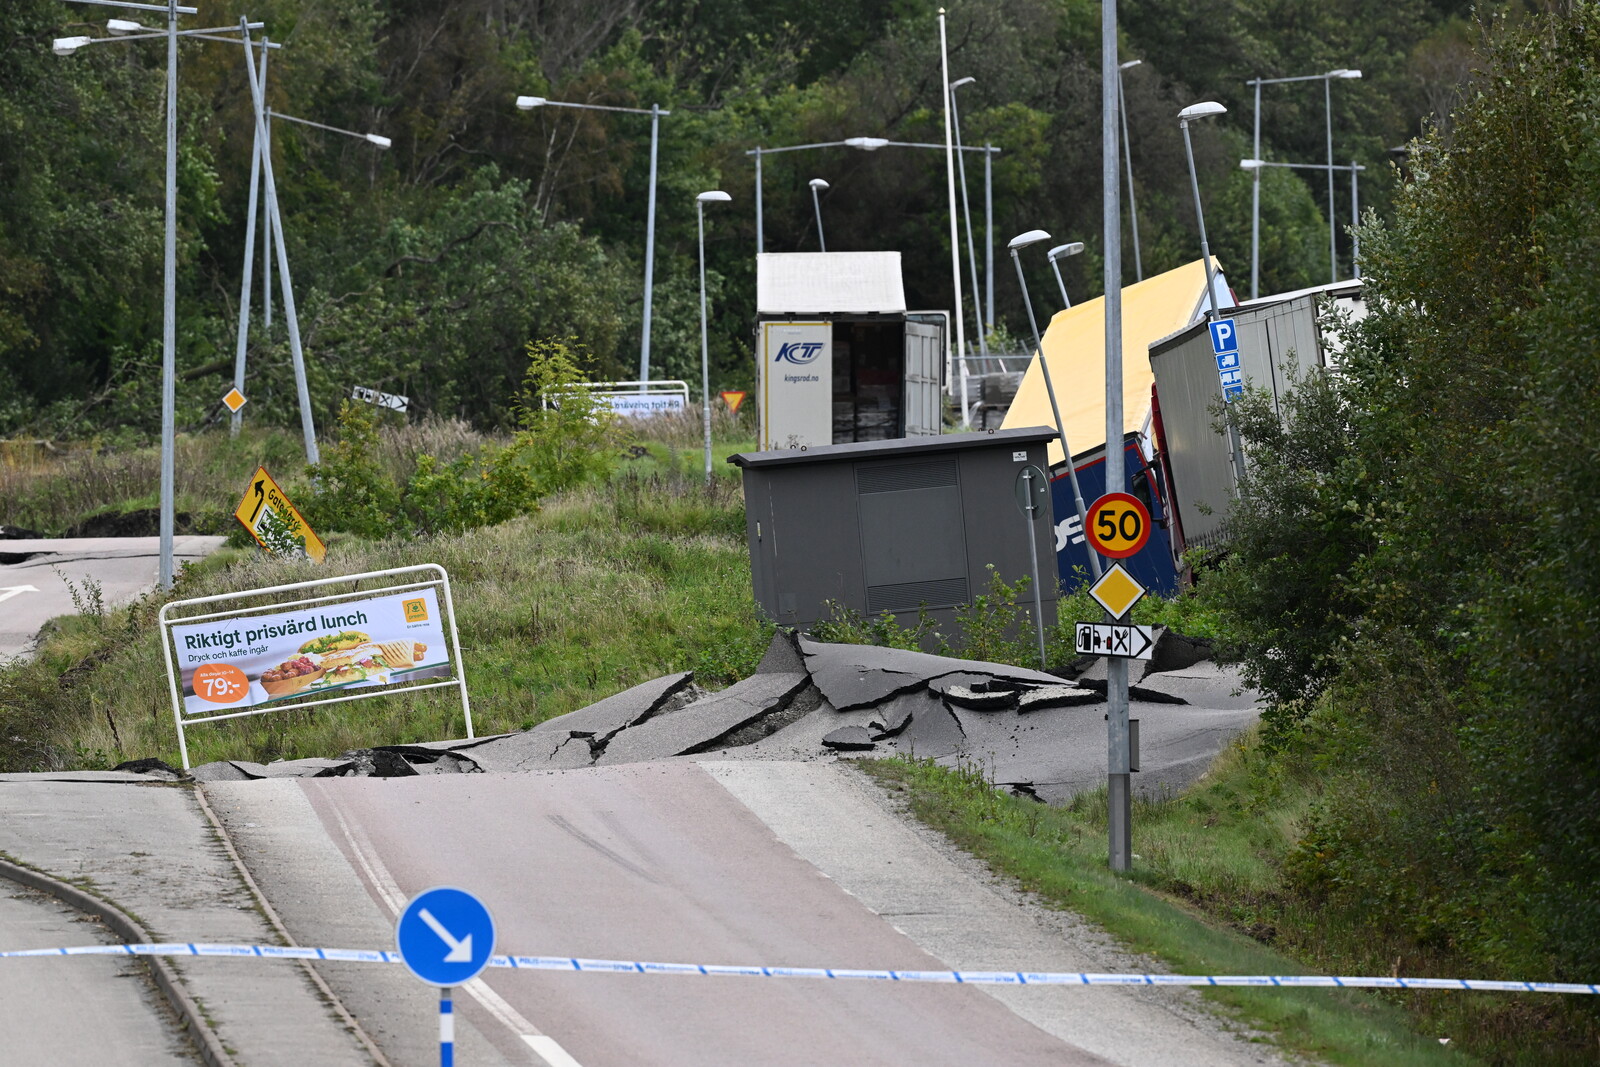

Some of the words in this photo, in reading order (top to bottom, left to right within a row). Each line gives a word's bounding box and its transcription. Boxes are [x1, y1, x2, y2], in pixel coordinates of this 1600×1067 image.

[1216, 323, 1232, 350] P
[1098, 510, 1141, 542] 50
[185, 630, 241, 650] Riktigt
[245, 616, 317, 645] prisvärd
[320, 610, 368, 630] lunch
[188, 651, 210, 663] Dryck
[212, 650, 227, 660] och
[228, 647, 248, 658] kaffe
[249, 644, 269, 656] ingår
[202, 677, 241, 697] 79:-
